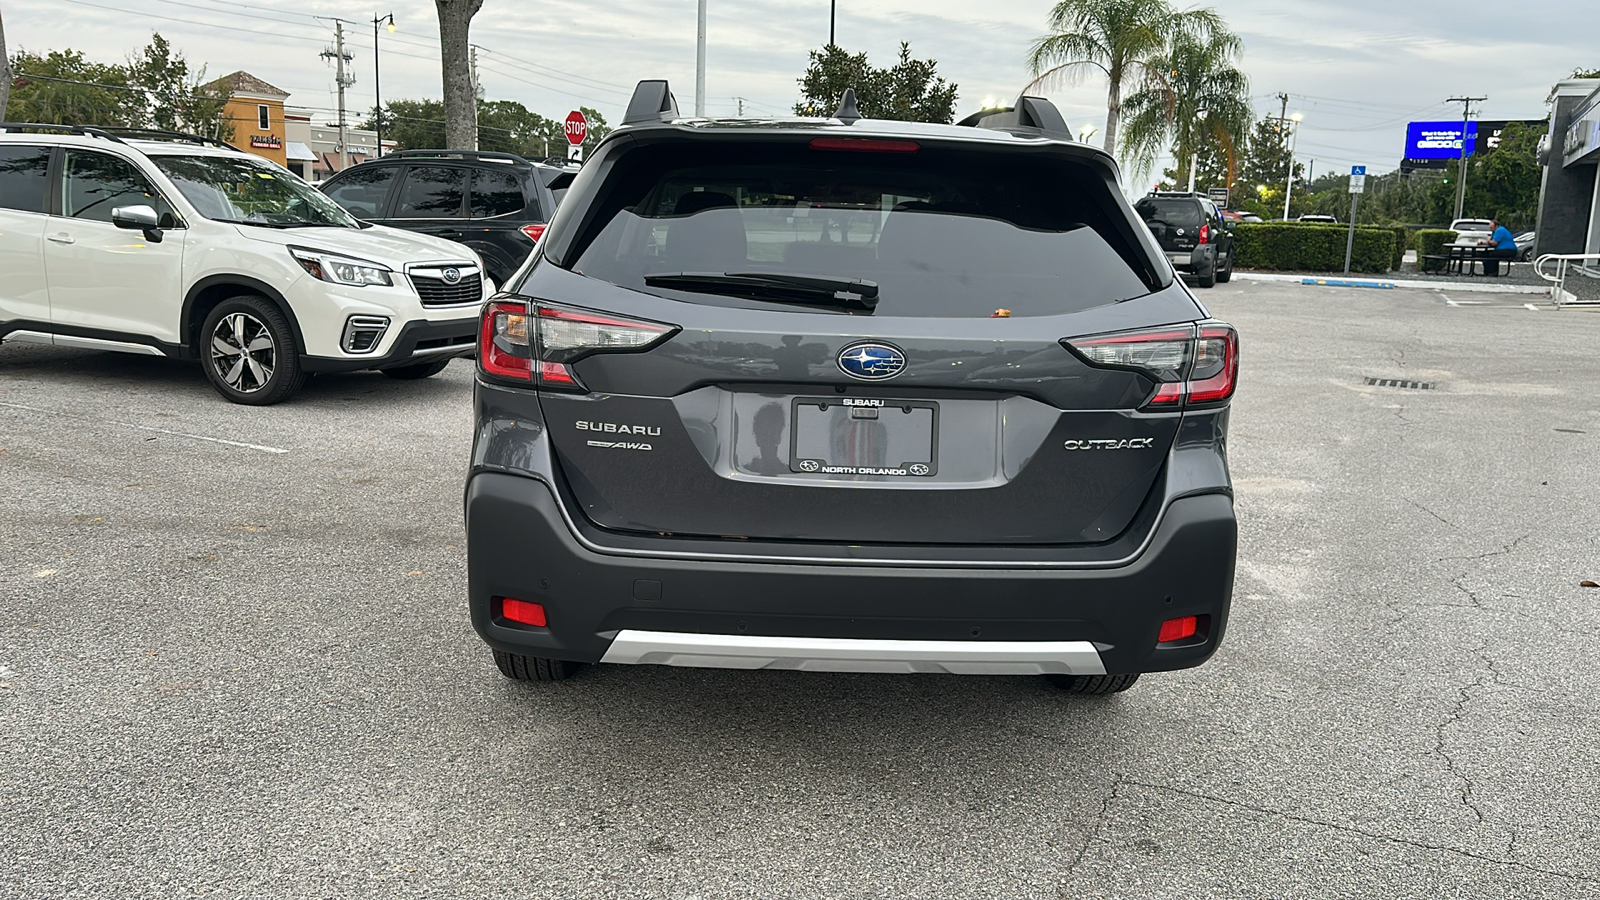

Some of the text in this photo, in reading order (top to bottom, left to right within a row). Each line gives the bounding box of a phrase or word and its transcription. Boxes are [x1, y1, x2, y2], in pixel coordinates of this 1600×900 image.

[566, 121, 585, 135] STOP
[1417, 140, 1452, 149] GEICO
[842, 399, 884, 407] SUBARU
[575, 420, 661, 436] SUBARU
[611, 442, 653, 450] AWD
[1064, 438, 1154, 450] OUTBACK
[821, 466, 907, 476] NORTH ORLANDO
